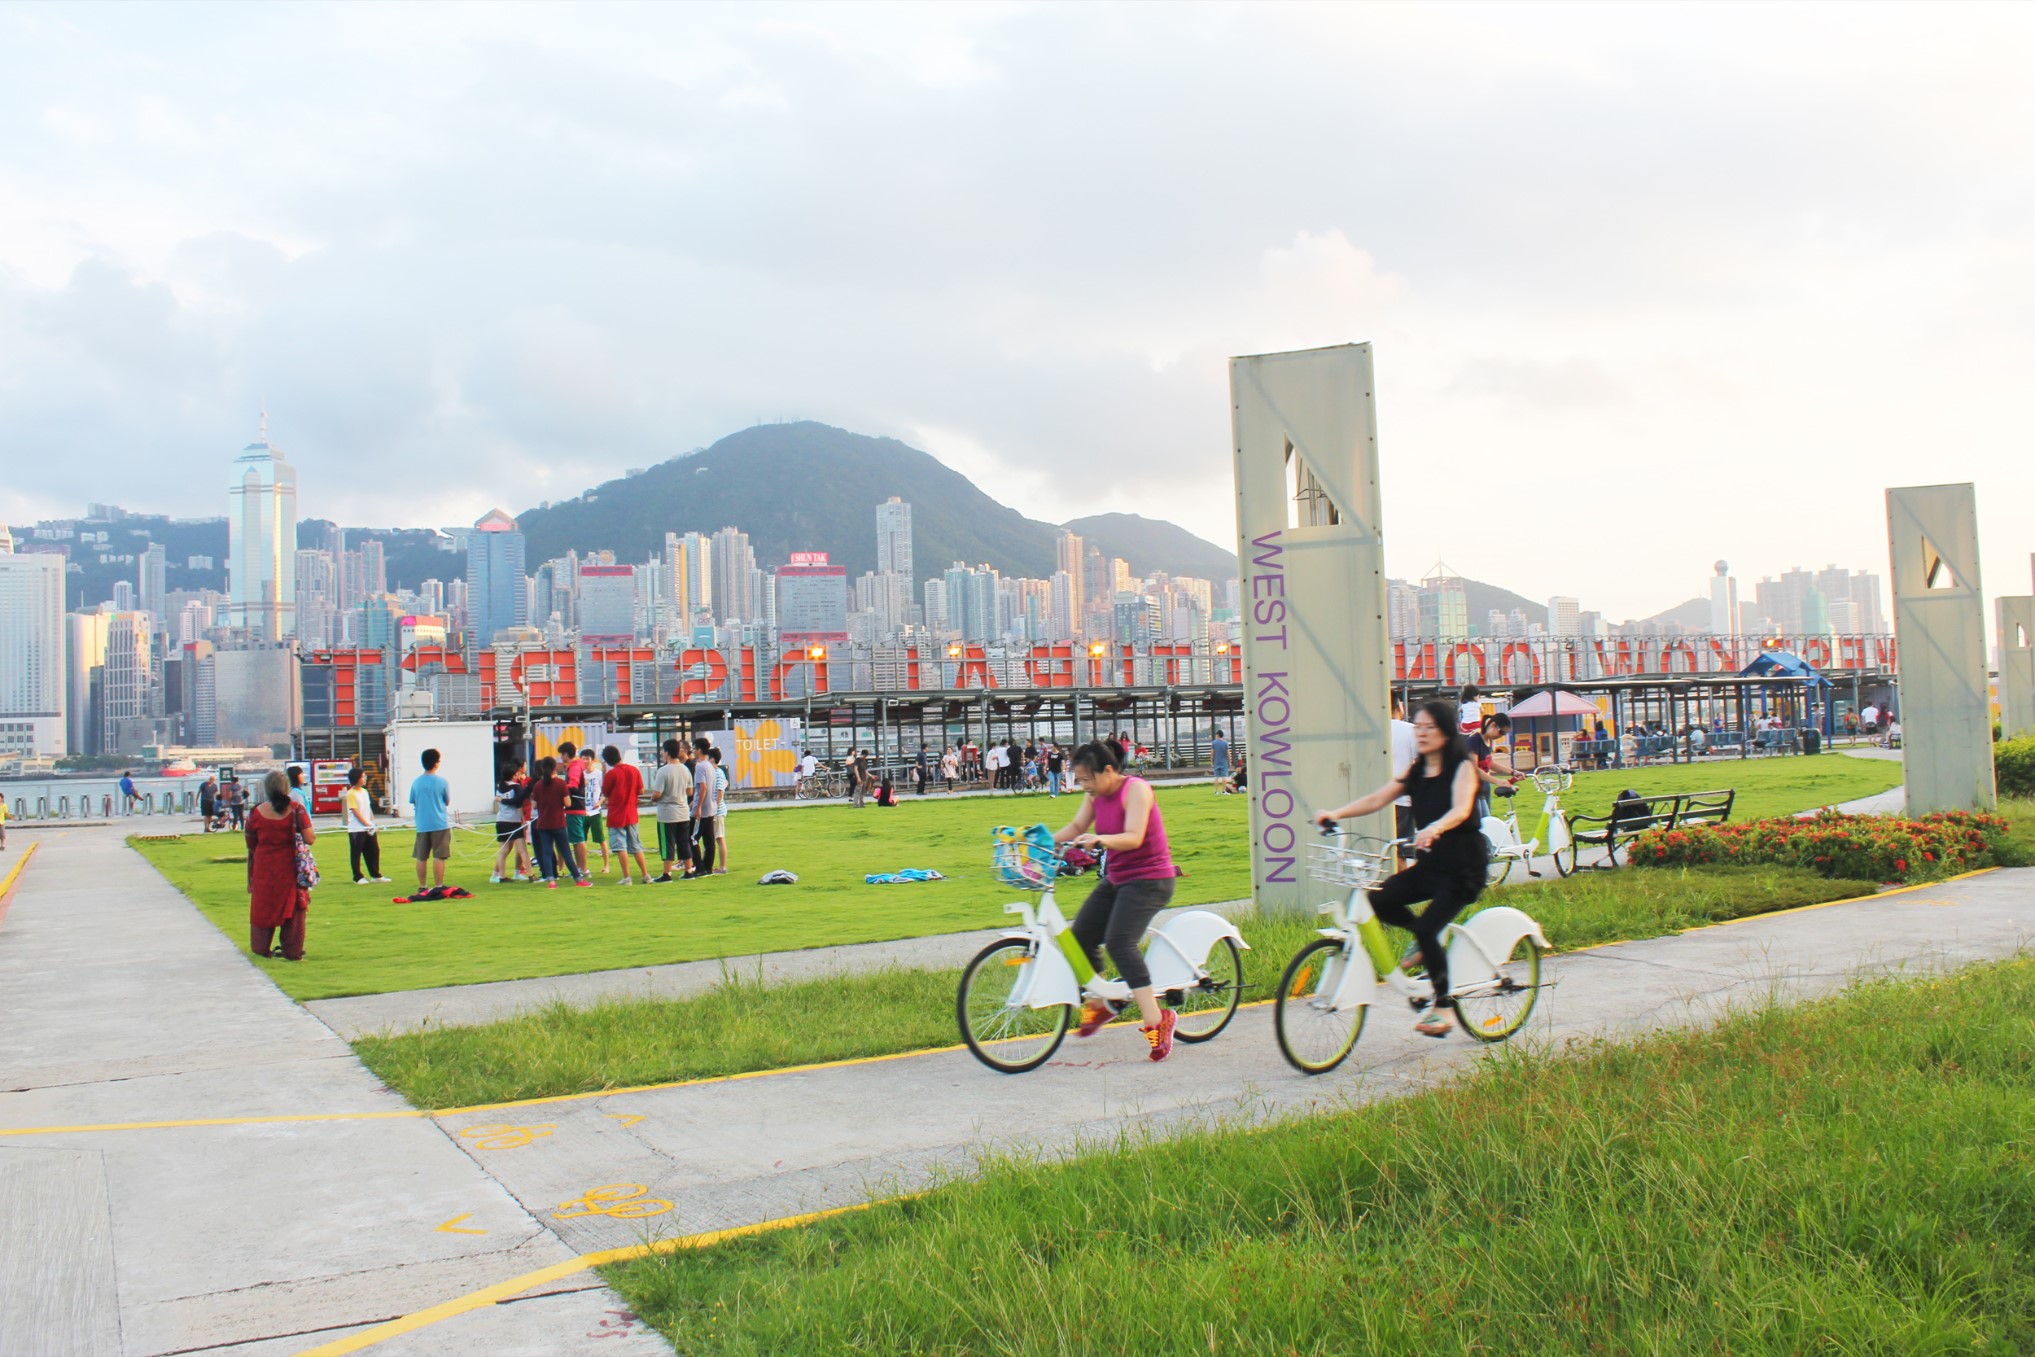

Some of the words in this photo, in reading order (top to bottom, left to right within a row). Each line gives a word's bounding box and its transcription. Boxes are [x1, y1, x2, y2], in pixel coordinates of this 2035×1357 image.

[794, 552, 812, 562] SHUN
[813, 552, 827, 562] TAK
[1251, 530, 1287, 650] WEST
[736, 738, 779, 751] TOILET
[1257, 671, 1297, 883] KOWLOON
